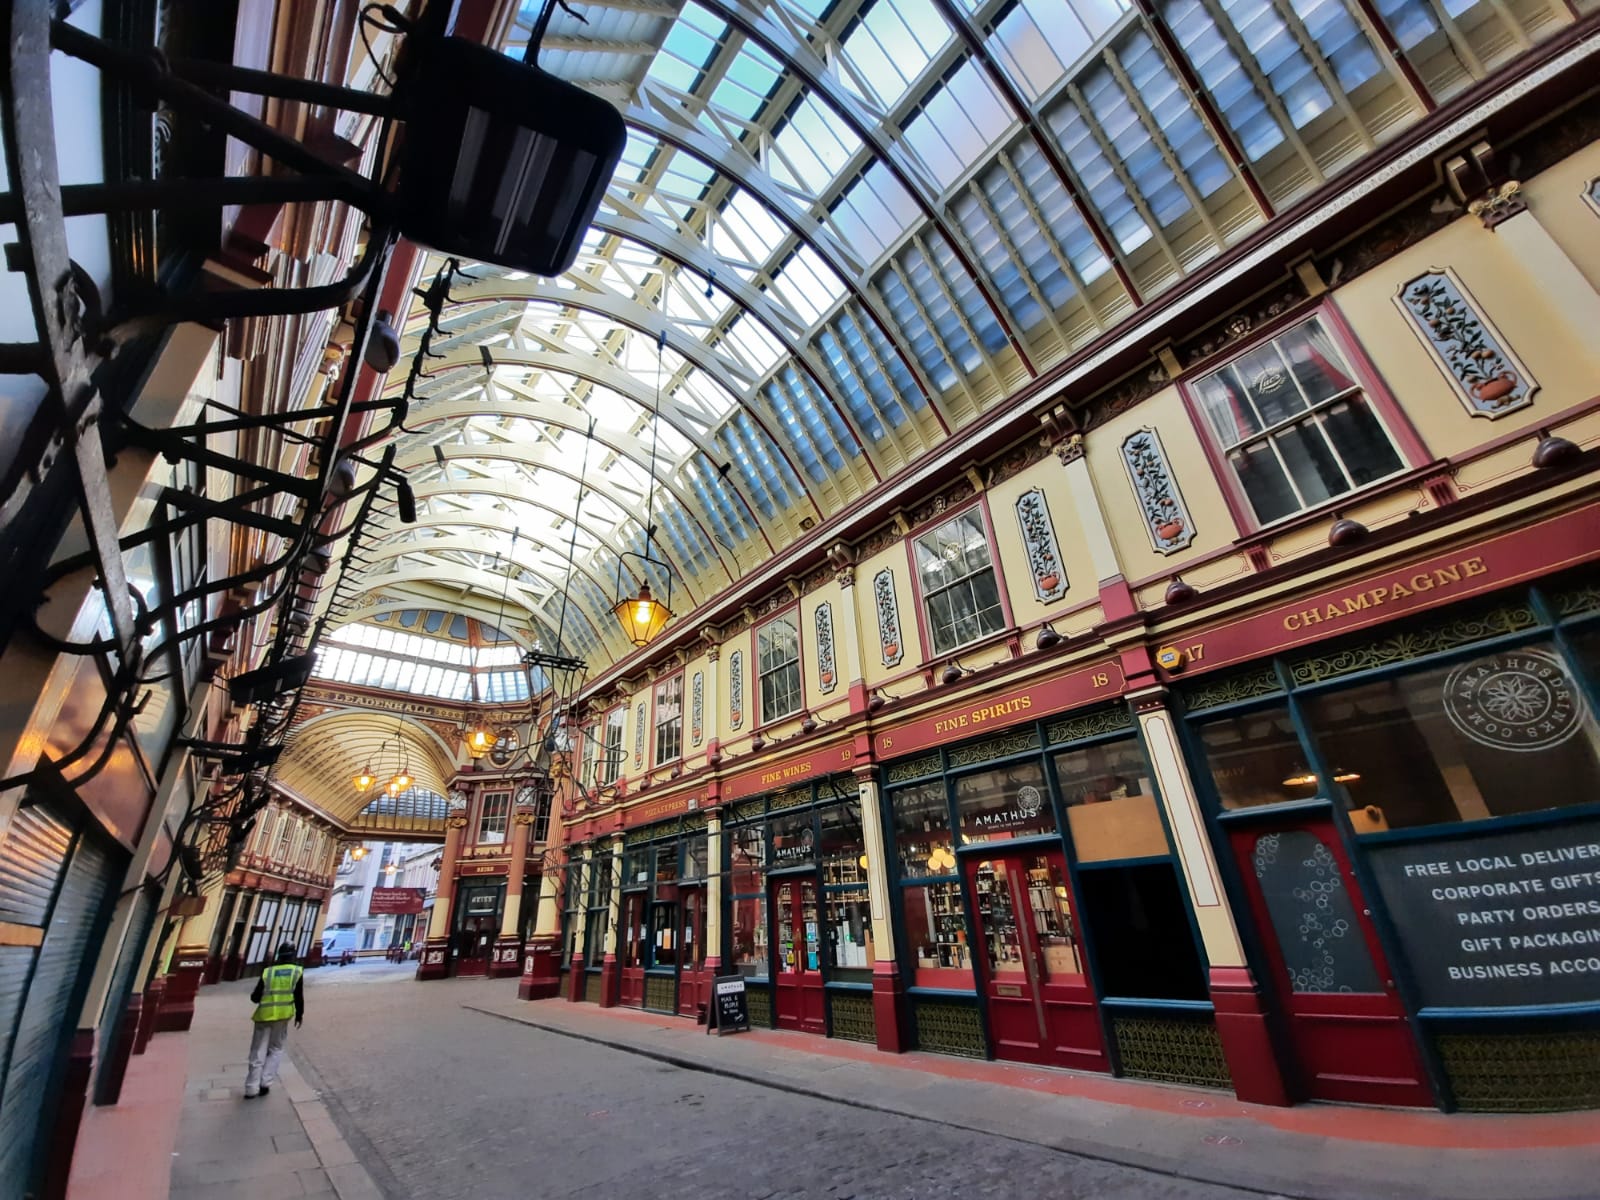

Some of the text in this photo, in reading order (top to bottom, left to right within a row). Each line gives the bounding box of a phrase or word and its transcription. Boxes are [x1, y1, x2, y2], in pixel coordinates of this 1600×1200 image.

[1282, 556, 1488, 632] CHAMPAGNE
[1184, 643, 1204, 662] 17
[1091, 672, 1109, 688] 18
[335, 693, 432, 715] LEADENHALL
[935, 695, 1032, 734] FINE SPIRITS
[882, 736, 893, 749] 18
[841, 750, 851, 761] 19
[761, 761, 812, 785] FINE WINES
[975, 808, 1037, 827] AMATHUS
[776, 845, 811, 858] AMATHUS
[1404, 861, 1451, 878] FREE
[1455, 855, 1517, 874] LOCAL
[1431, 879, 1546, 901] CORPORATE
[1457, 900, 1600, 926] PARTY ORDERS
[1460, 936, 1502, 952] GIFT
[1448, 962, 1543, 980] BUSINESS
